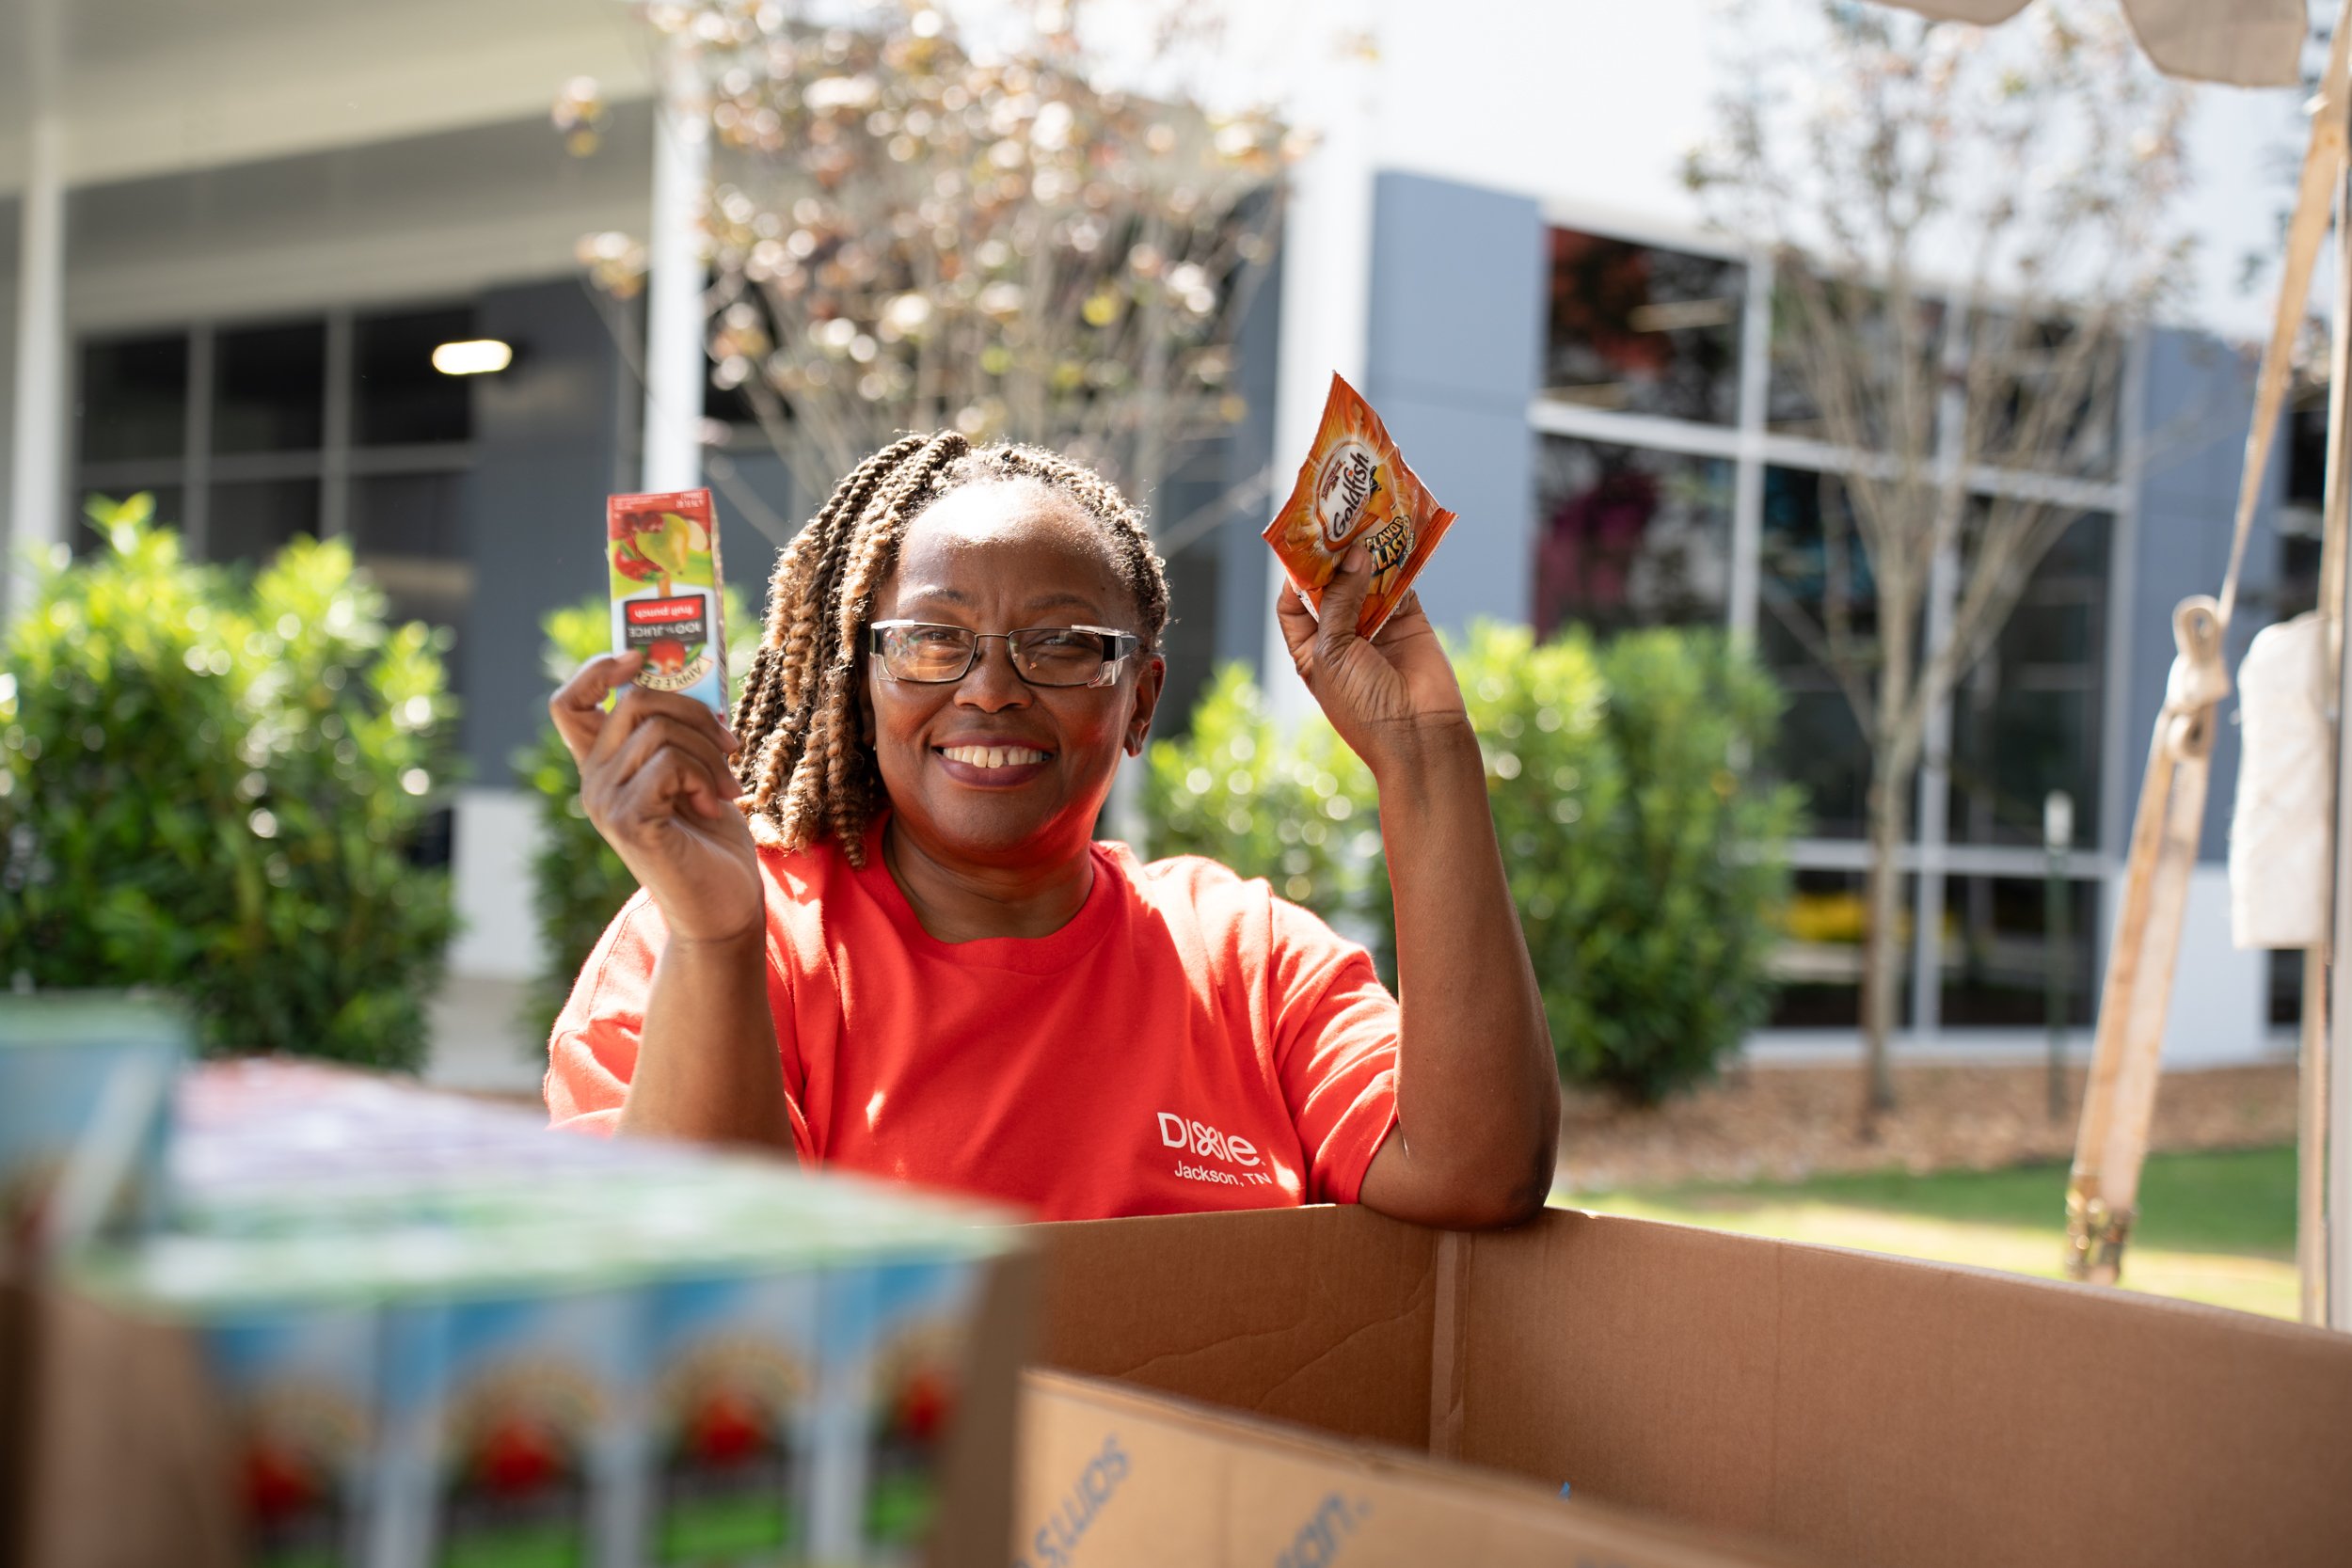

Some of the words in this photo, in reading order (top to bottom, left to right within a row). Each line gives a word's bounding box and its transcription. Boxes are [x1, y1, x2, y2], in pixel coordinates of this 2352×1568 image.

[1332, 451, 1370, 539] Goldfish
[1365, 516, 1406, 550] FLAVOR
[634, 606, 670, 620] punch
[670, 605, 694, 618] fruit
[628, 624, 664, 638] JUICE
[664, 660, 704, 690] APPLE
[1174, 1160, 1245, 1187] Jackson,
[1243, 1172, 1272, 1185] TN
